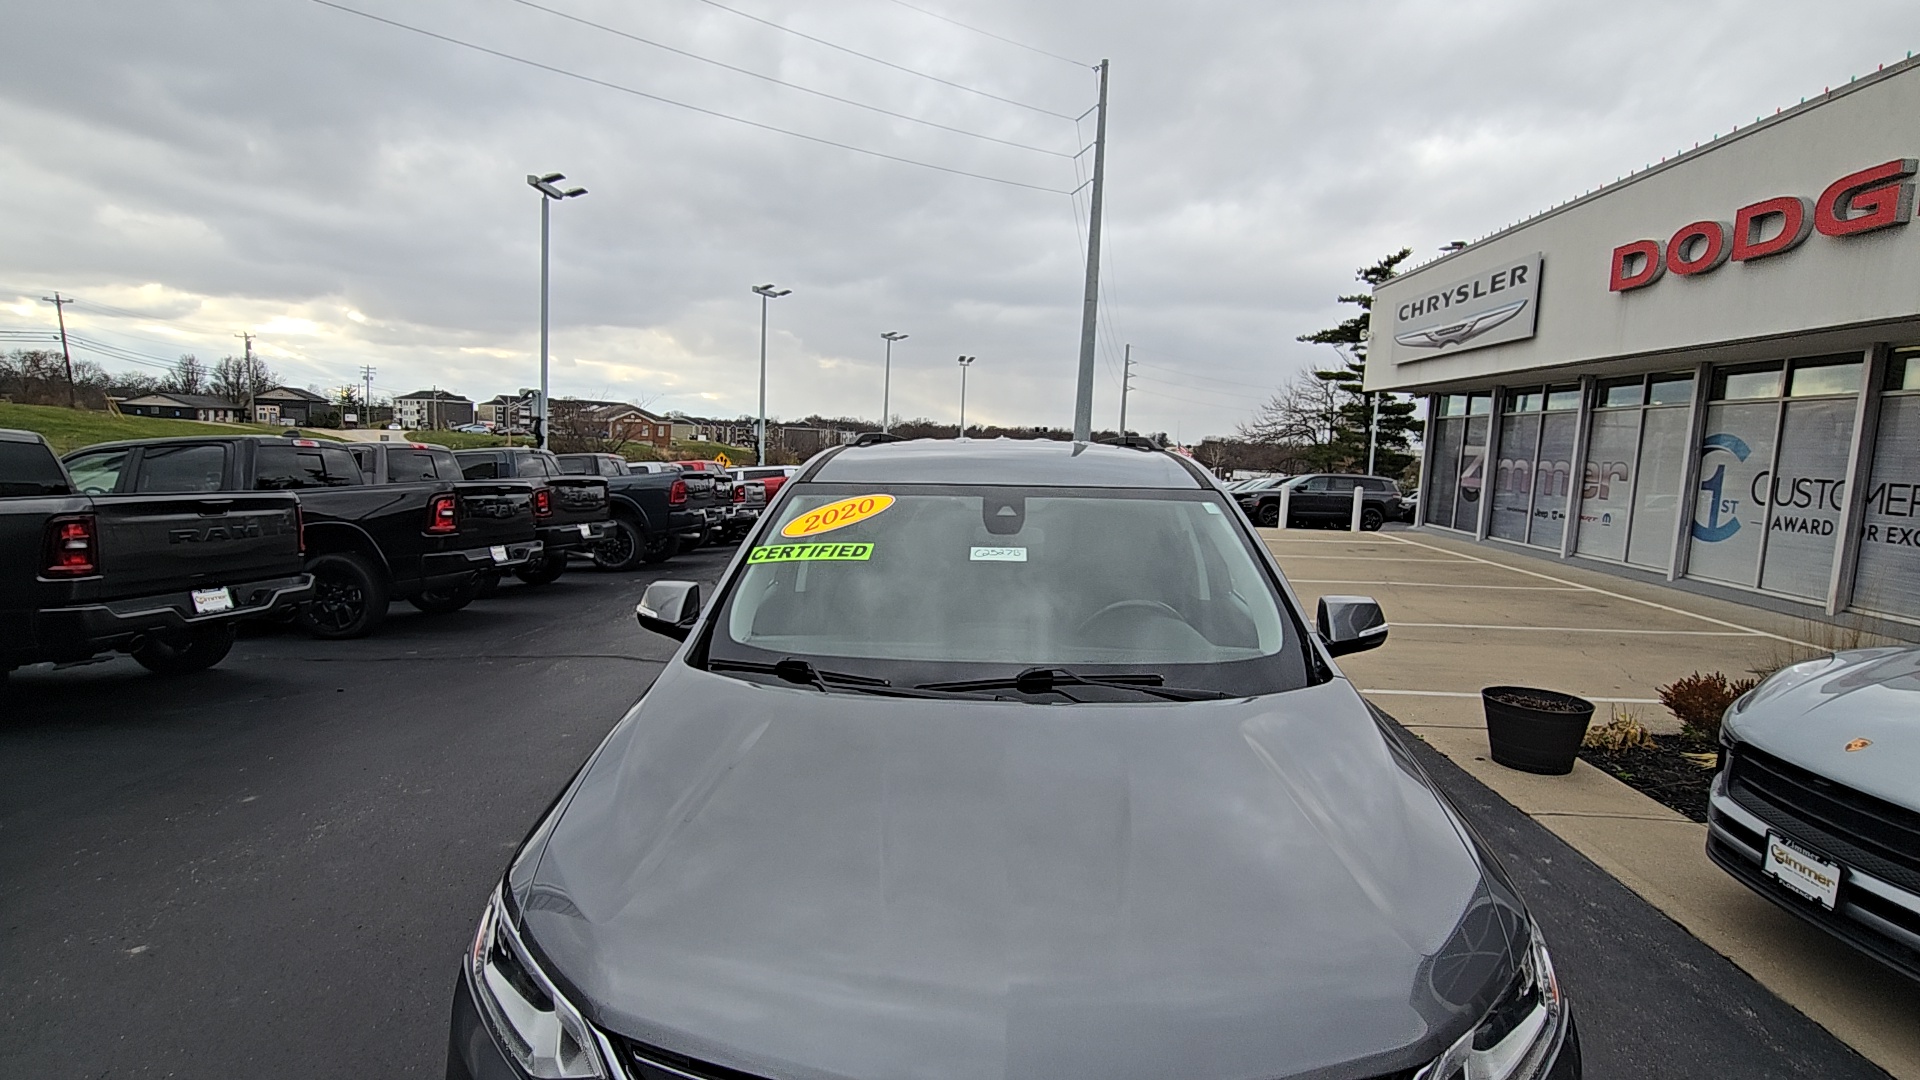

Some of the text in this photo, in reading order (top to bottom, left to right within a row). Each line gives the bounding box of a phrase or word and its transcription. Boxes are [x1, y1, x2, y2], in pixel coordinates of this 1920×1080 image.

[1609, 158, 1920, 292] DODG
[1399, 265, 1528, 321] CHRYSLER
[1461, 445, 1628, 501] Zmmer
[168, 525, 260, 544] RAM
[803, 498, 875, 533] 2020
[1771, 516, 1834, 536] AWARD
[751, 545, 868, 560] CERTIFIED
[1771, 844, 1836, 888] Zimmer
